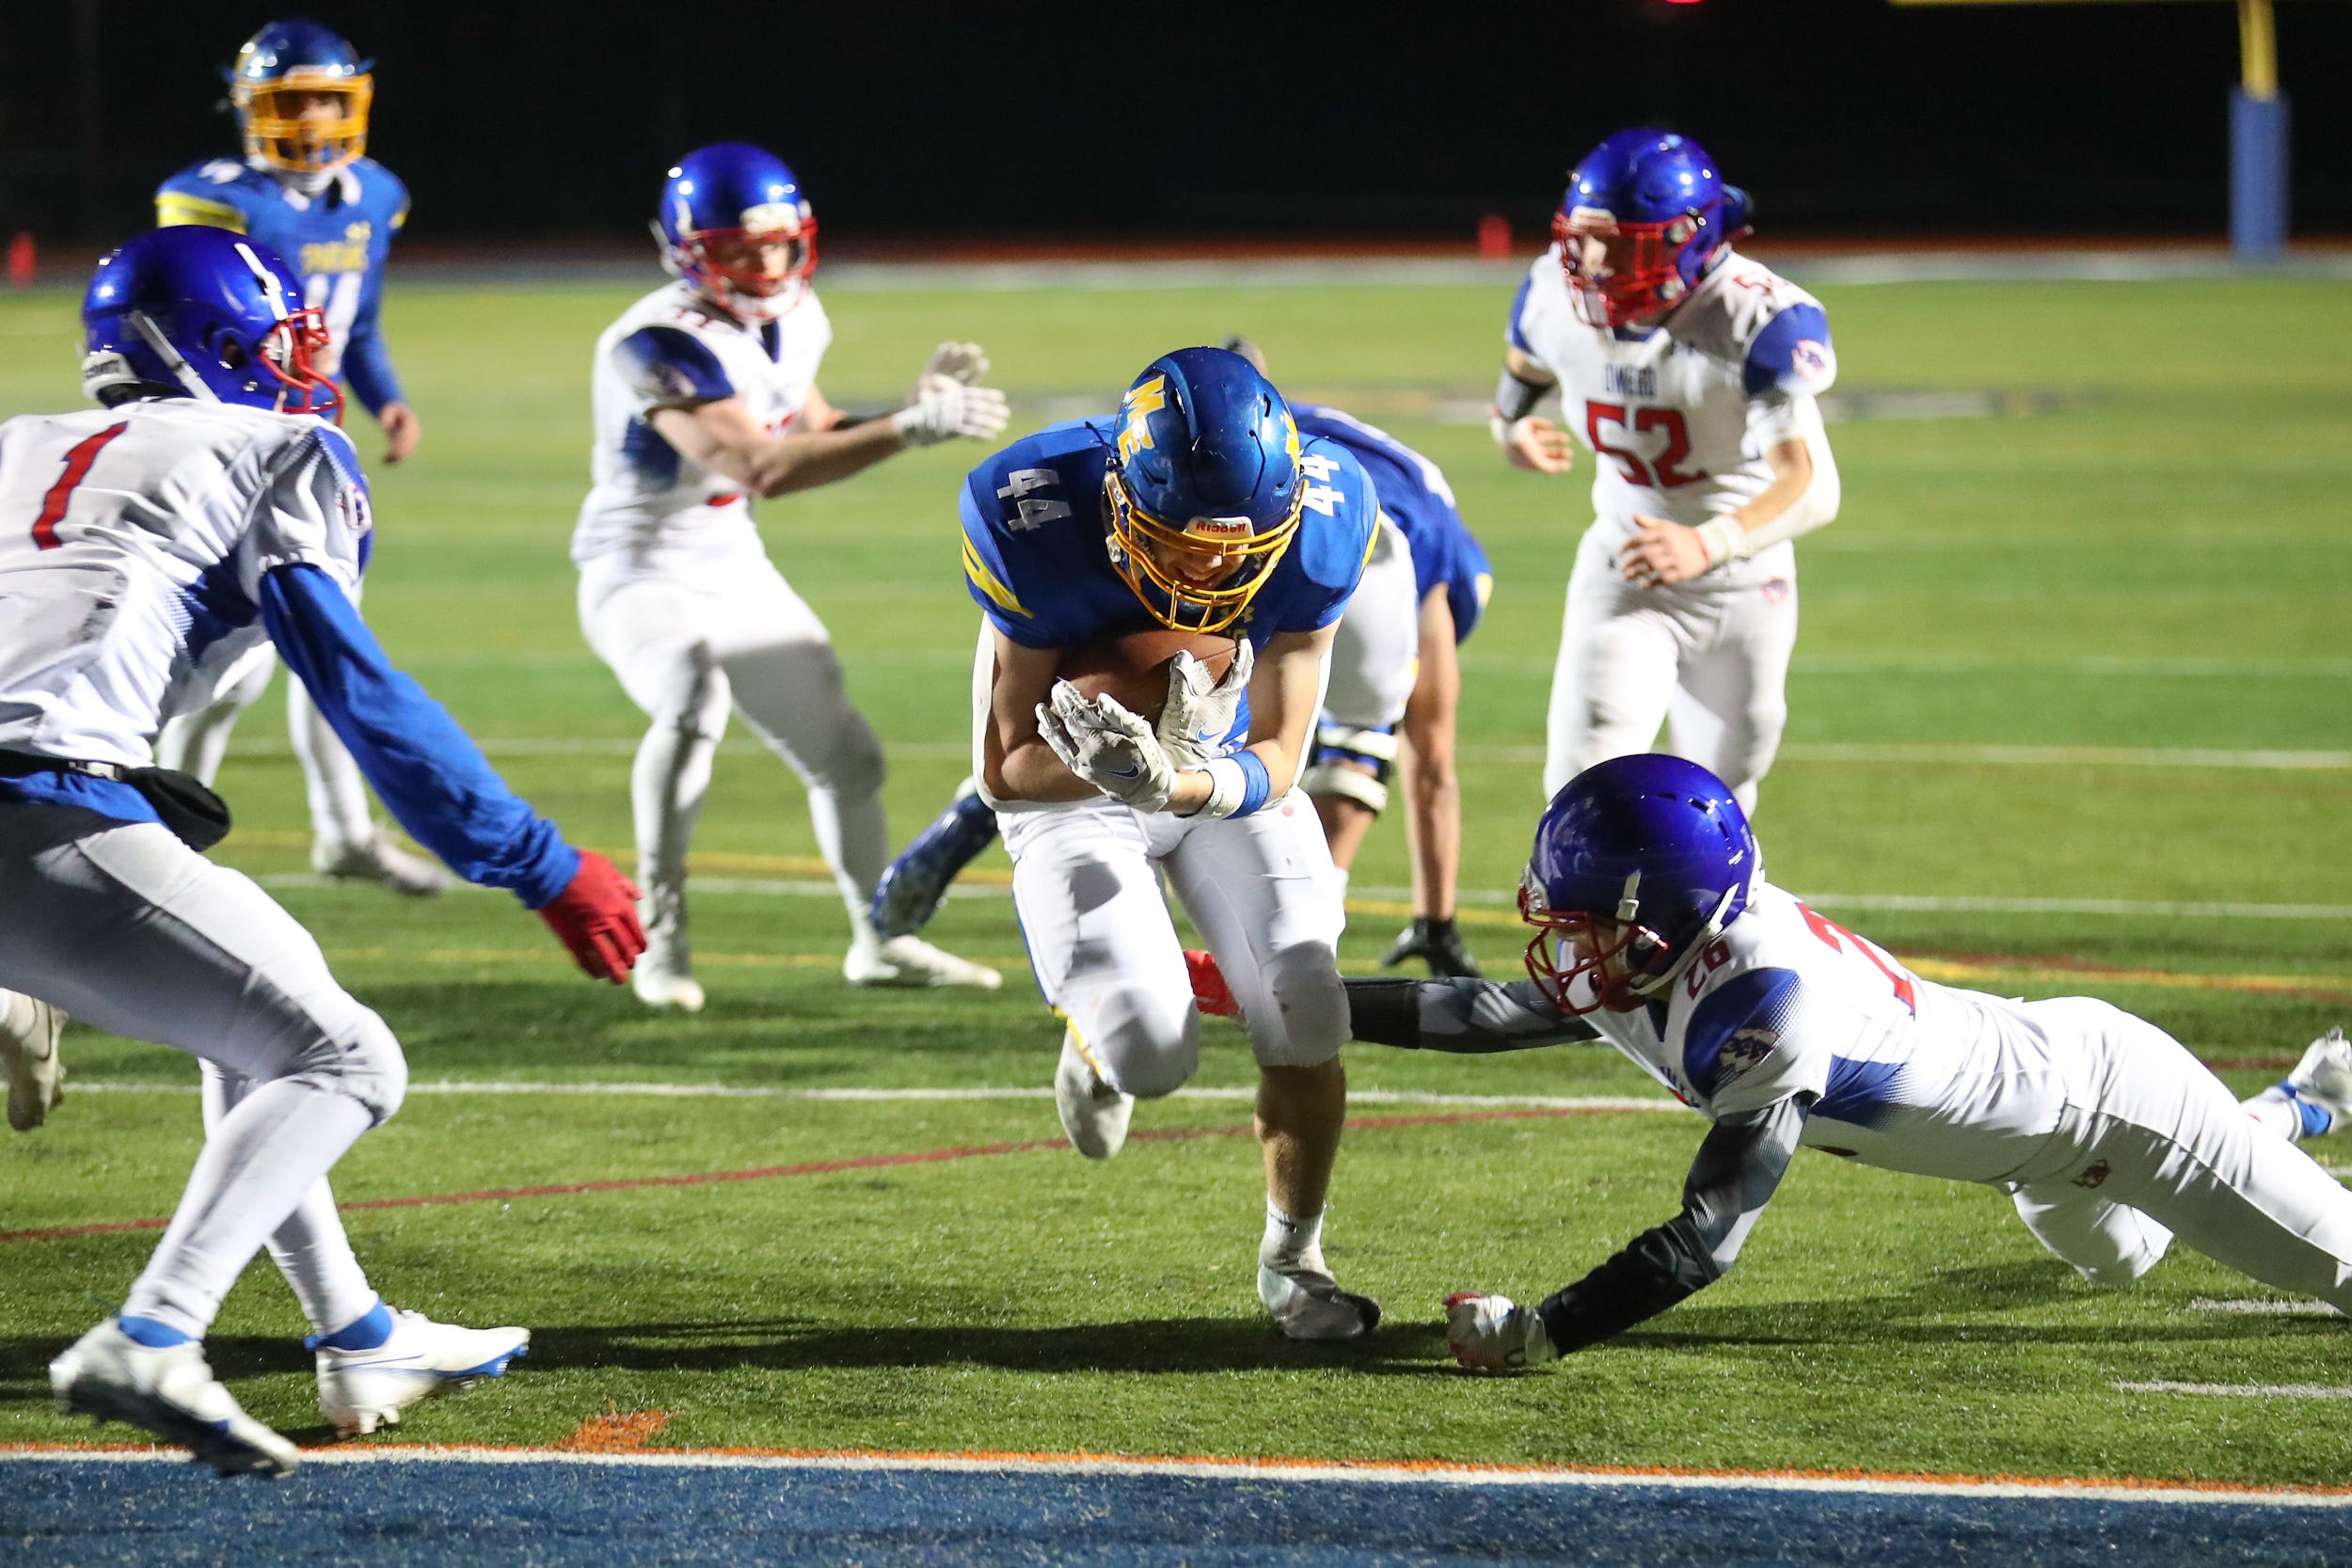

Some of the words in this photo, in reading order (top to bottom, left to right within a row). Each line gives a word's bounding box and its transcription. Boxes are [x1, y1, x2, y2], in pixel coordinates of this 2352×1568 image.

[1585, 400, 1708, 488] 52
[31, 420, 130, 551] 1
[996, 467, 1073, 531] 44
[1300, 453, 1345, 516] 44
[1196, 521, 1247, 533] Riddell
